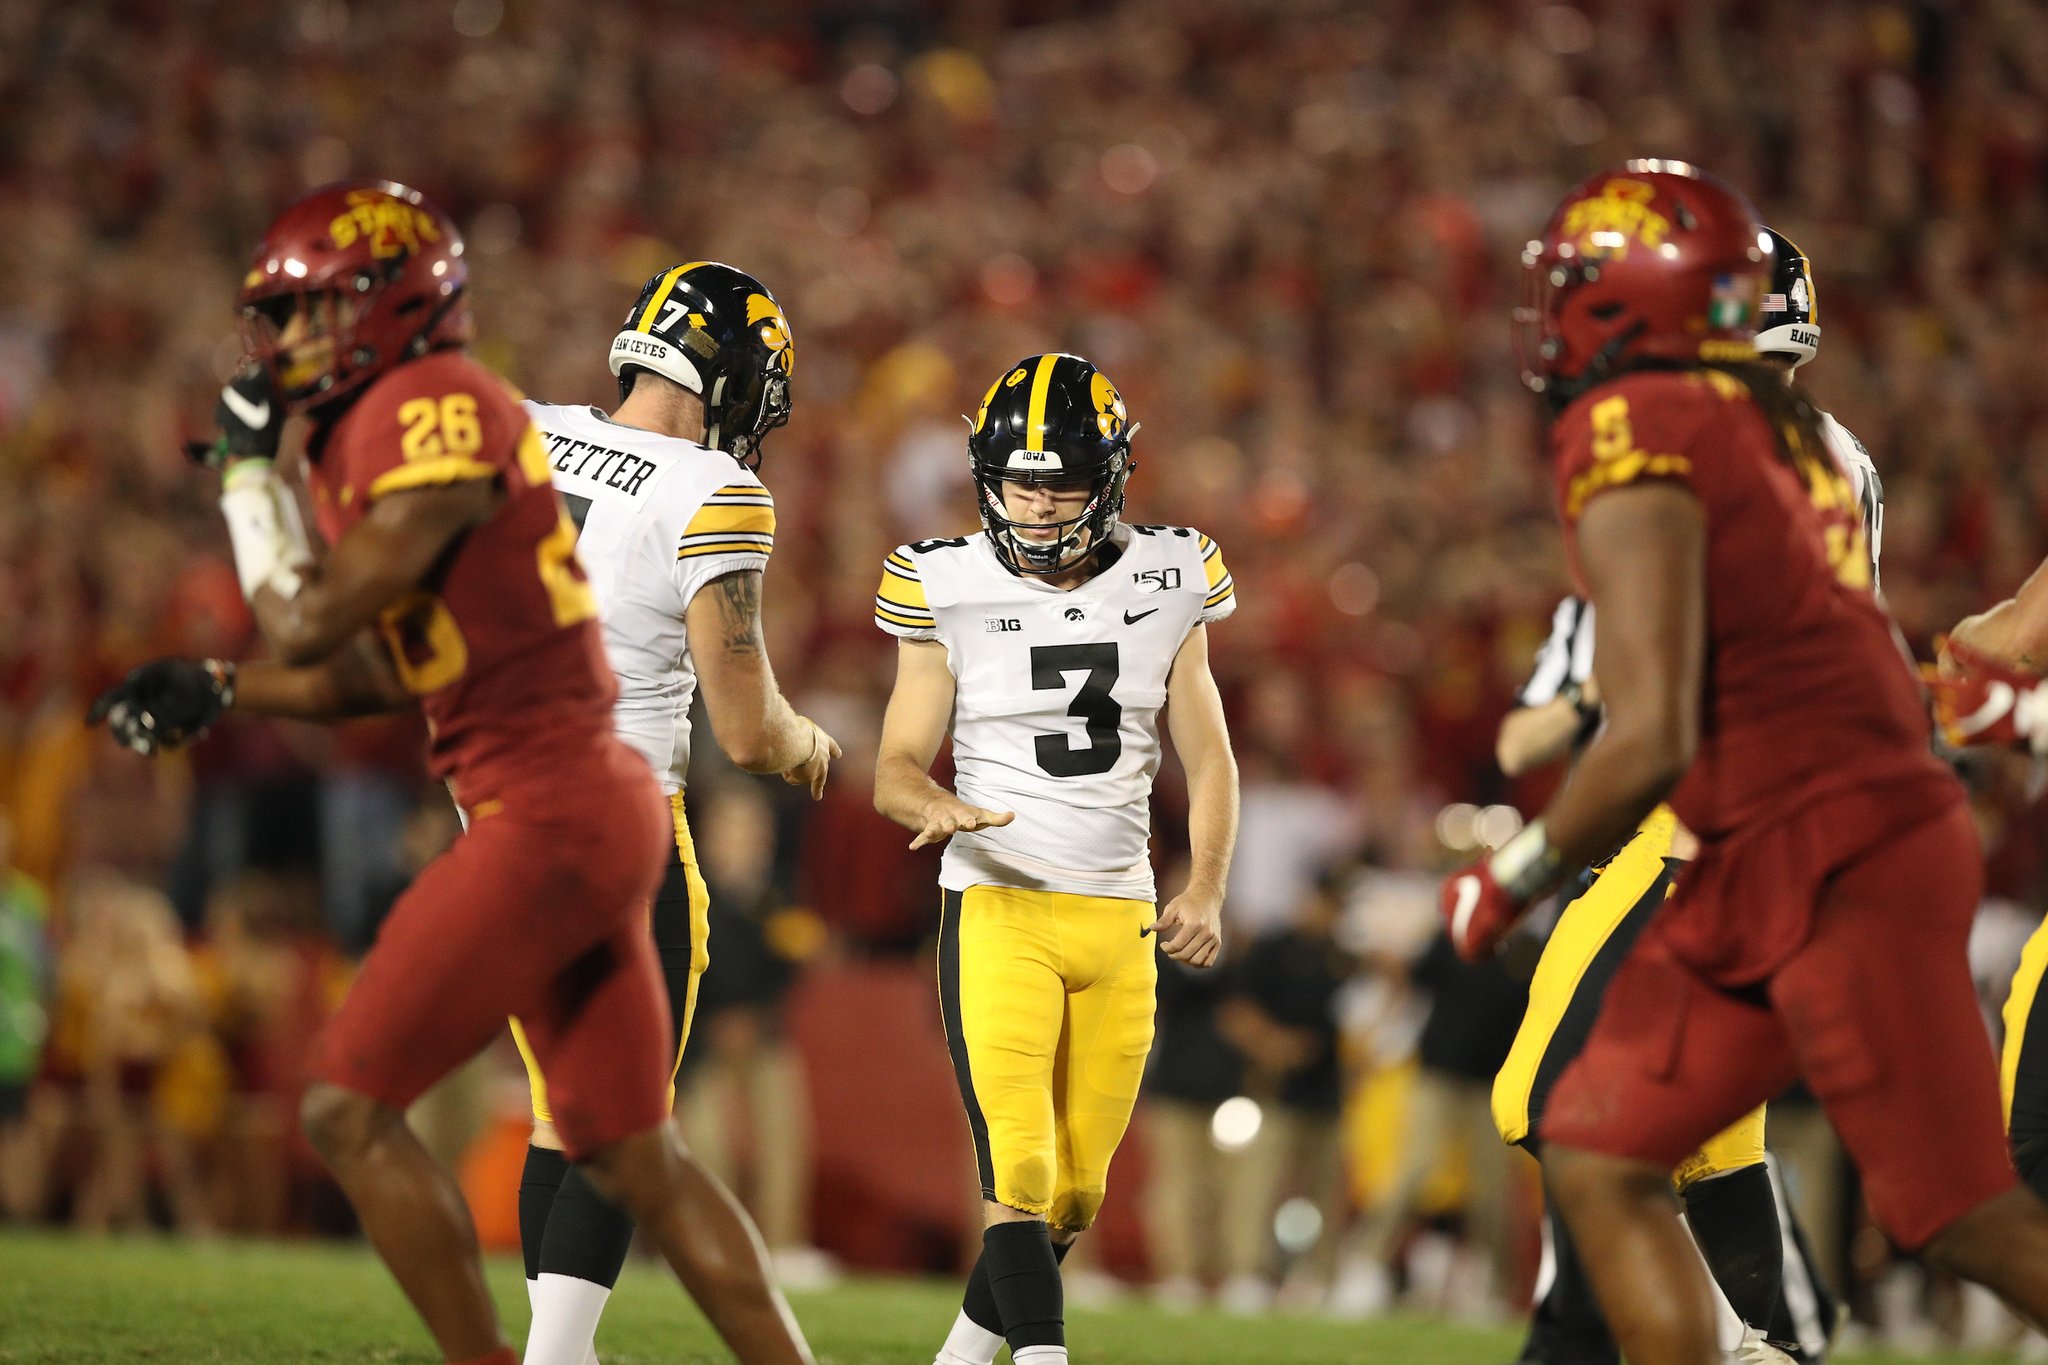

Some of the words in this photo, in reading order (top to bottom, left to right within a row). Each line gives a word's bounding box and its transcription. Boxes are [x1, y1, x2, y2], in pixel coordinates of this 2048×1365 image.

[652, 299, 690, 334] 7
[397, 392, 482, 463] 26
[1022, 451, 1047, 462] IOWA
[1132, 567, 1182, 592] 150
[1030, 641, 1122, 777] 3
